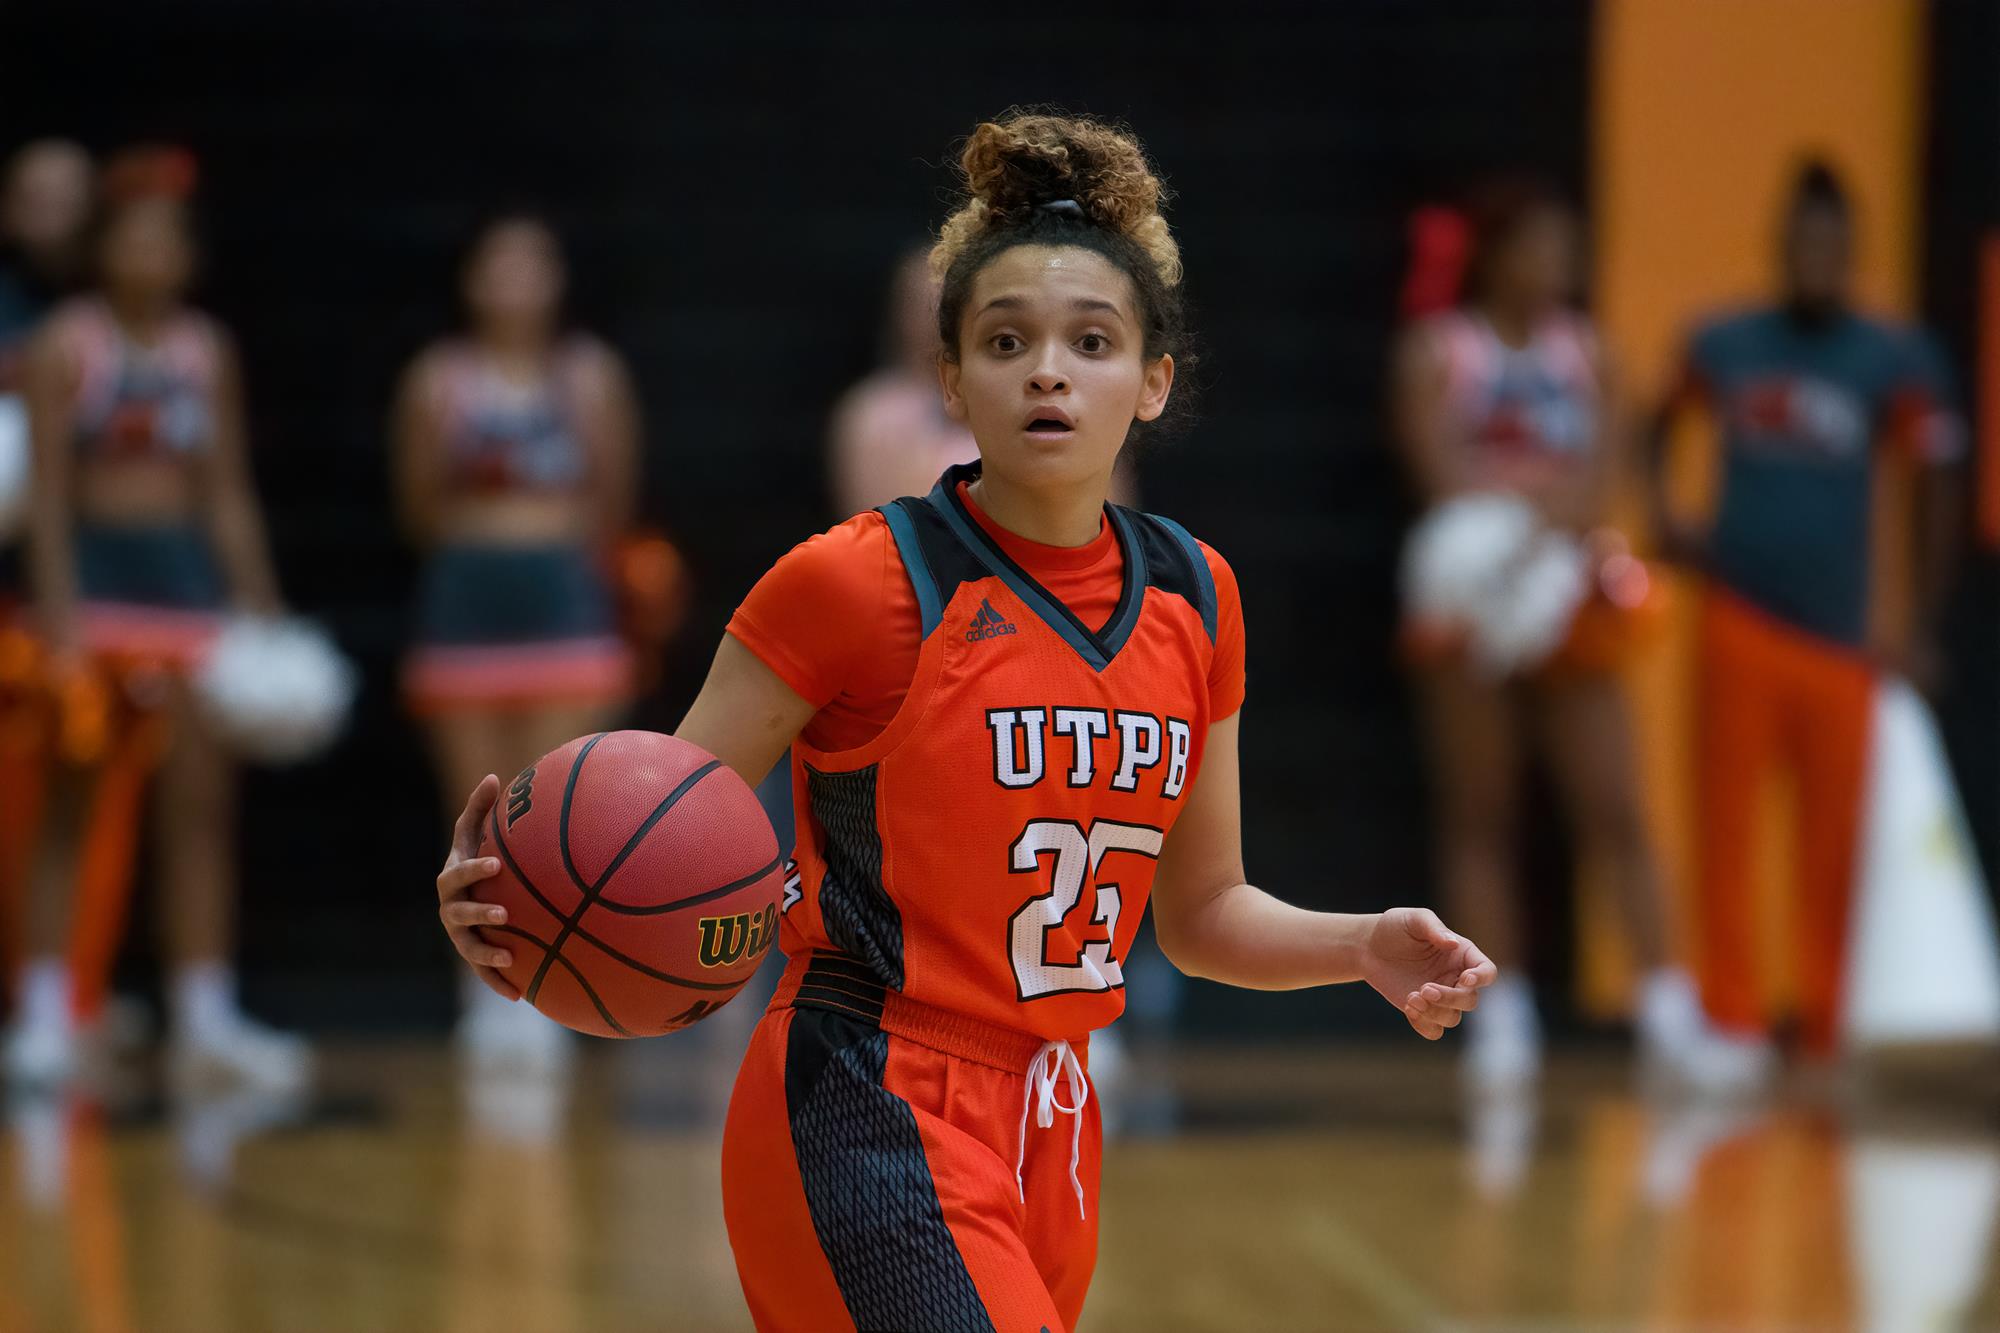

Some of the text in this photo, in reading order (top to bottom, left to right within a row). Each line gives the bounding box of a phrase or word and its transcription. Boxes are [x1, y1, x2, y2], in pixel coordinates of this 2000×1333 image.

[966, 623, 1017, 643] adidas
[985, 706, 1191, 800] UTPB
[698, 902, 779, 968] Wil
